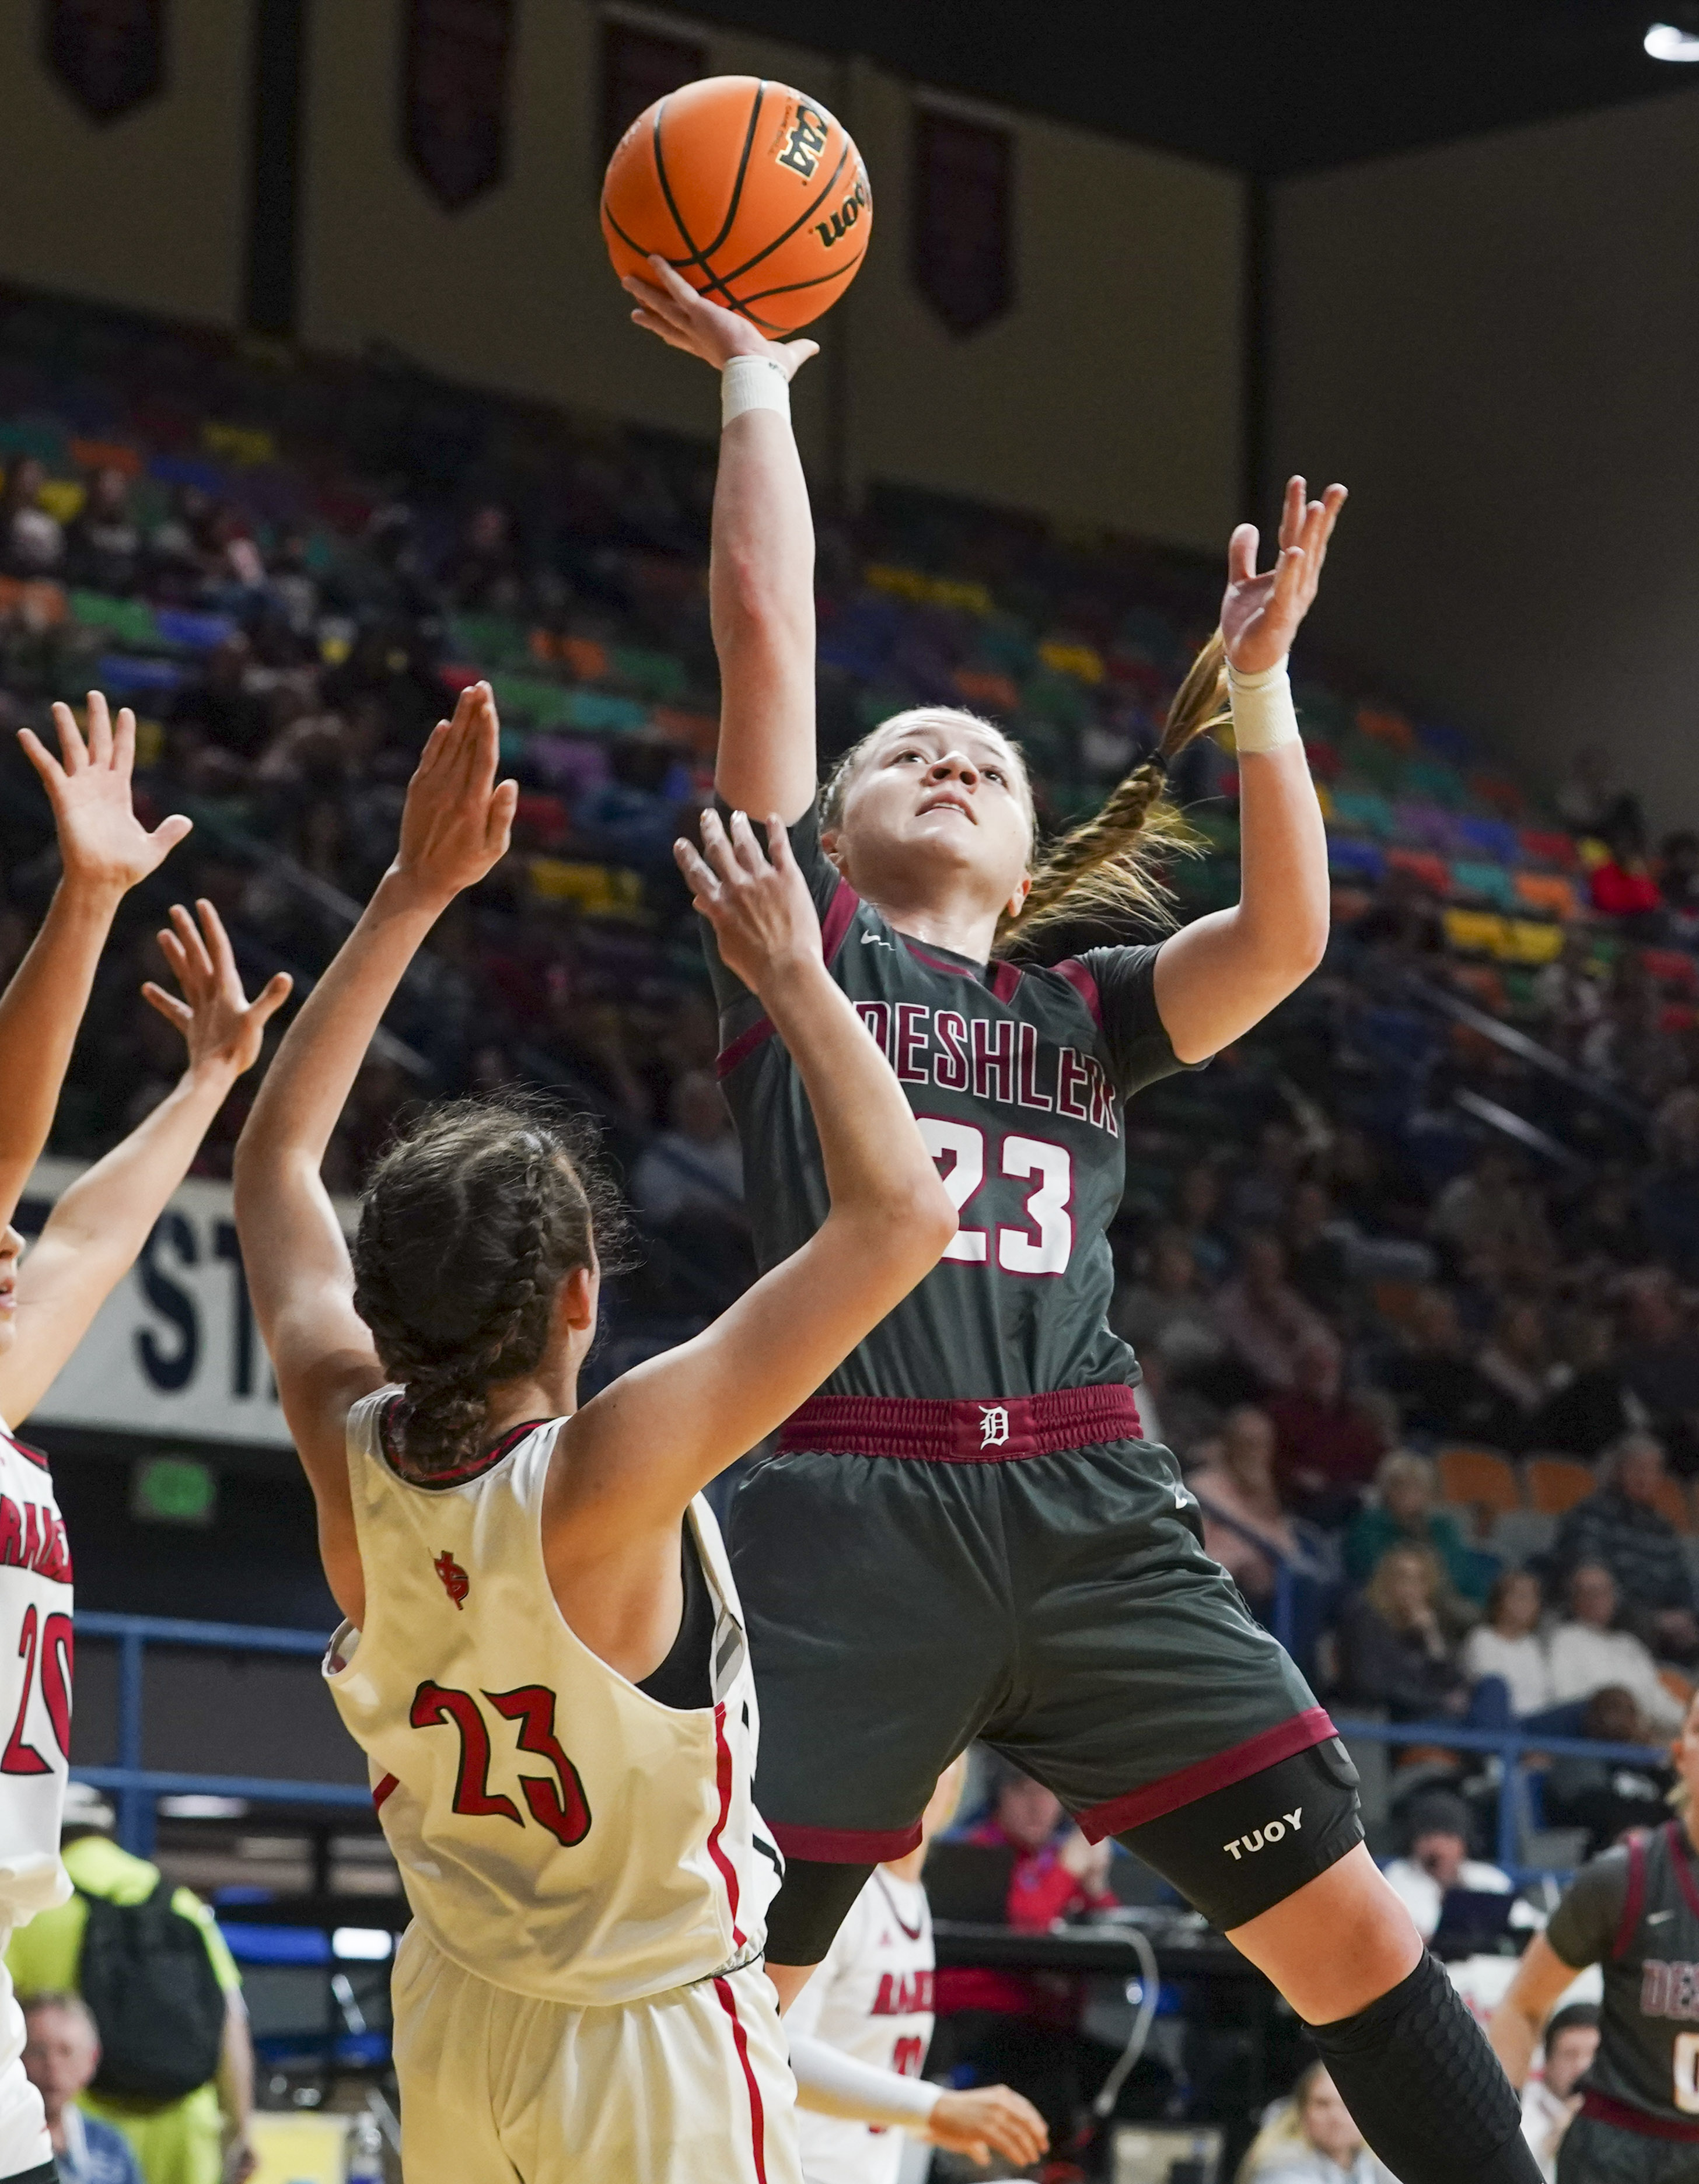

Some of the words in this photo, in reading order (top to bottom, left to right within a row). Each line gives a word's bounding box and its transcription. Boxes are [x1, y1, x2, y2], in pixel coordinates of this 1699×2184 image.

[775, 100, 827, 181] CAA
[853, 1001, 1118, 1138] DESHLER
[915, 1113, 1074, 1276] 23
[133, 1209, 279, 1403] ST
[978, 1405, 1009, 1450] D
[0, 1604, 74, 1775] 20
[410, 1679, 592, 1848] 23
[1223, 1807, 1302, 1860] TUOY
[1640, 1958, 1699, 2021] DE
